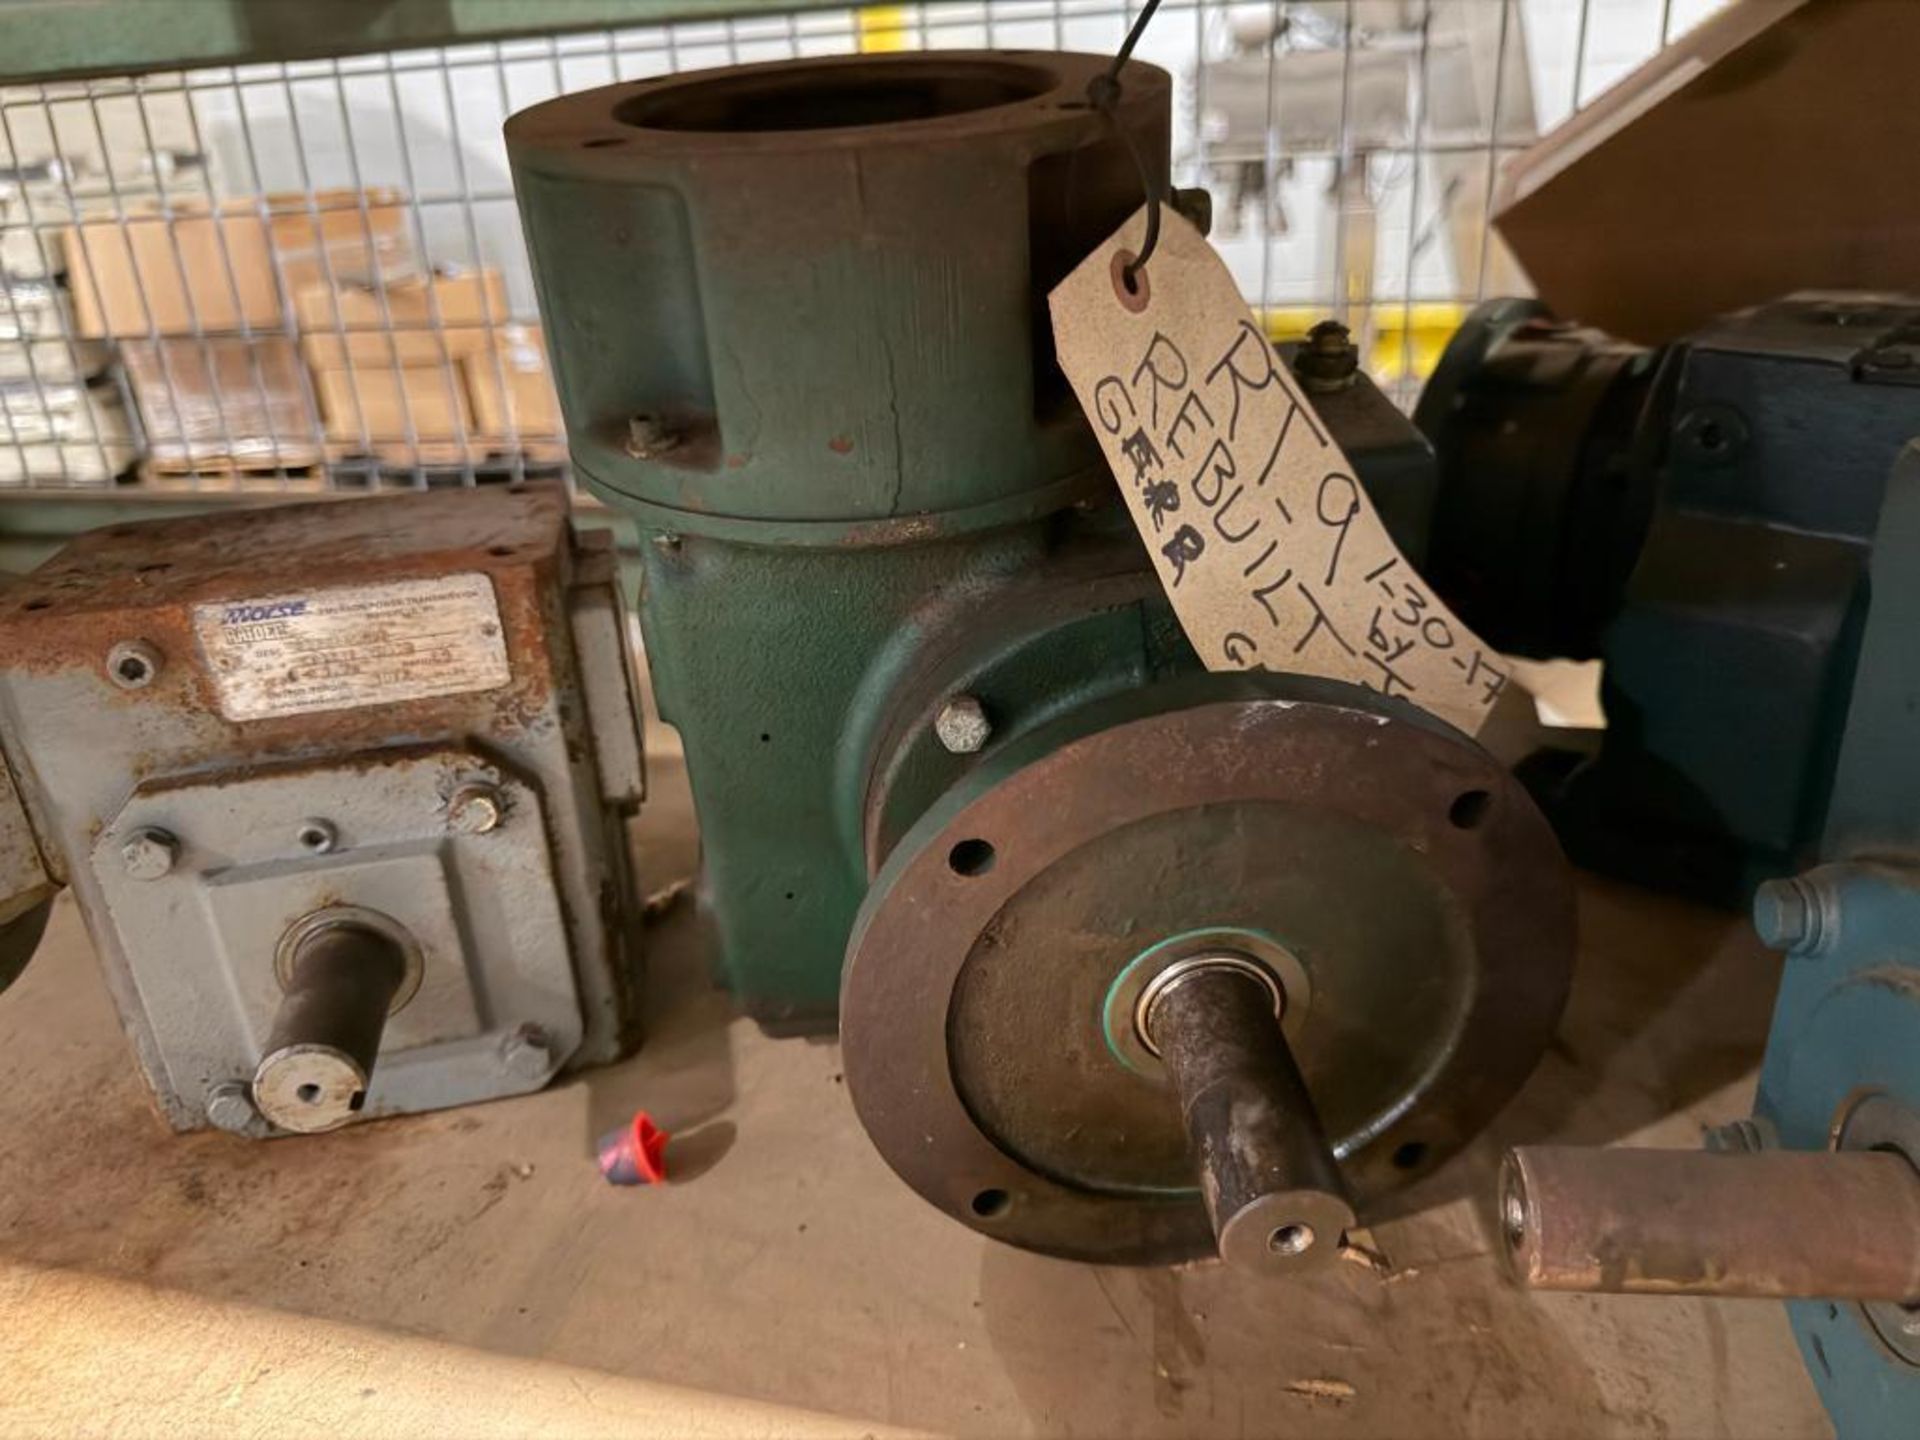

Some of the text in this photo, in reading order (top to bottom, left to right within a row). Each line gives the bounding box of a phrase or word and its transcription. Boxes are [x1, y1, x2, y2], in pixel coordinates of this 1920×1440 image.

[1132, 331, 1356, 657] REBUILT
[1206, 319, 1360, 585] RT-9
[1364, 557, 1506, 704] 1-30-17
